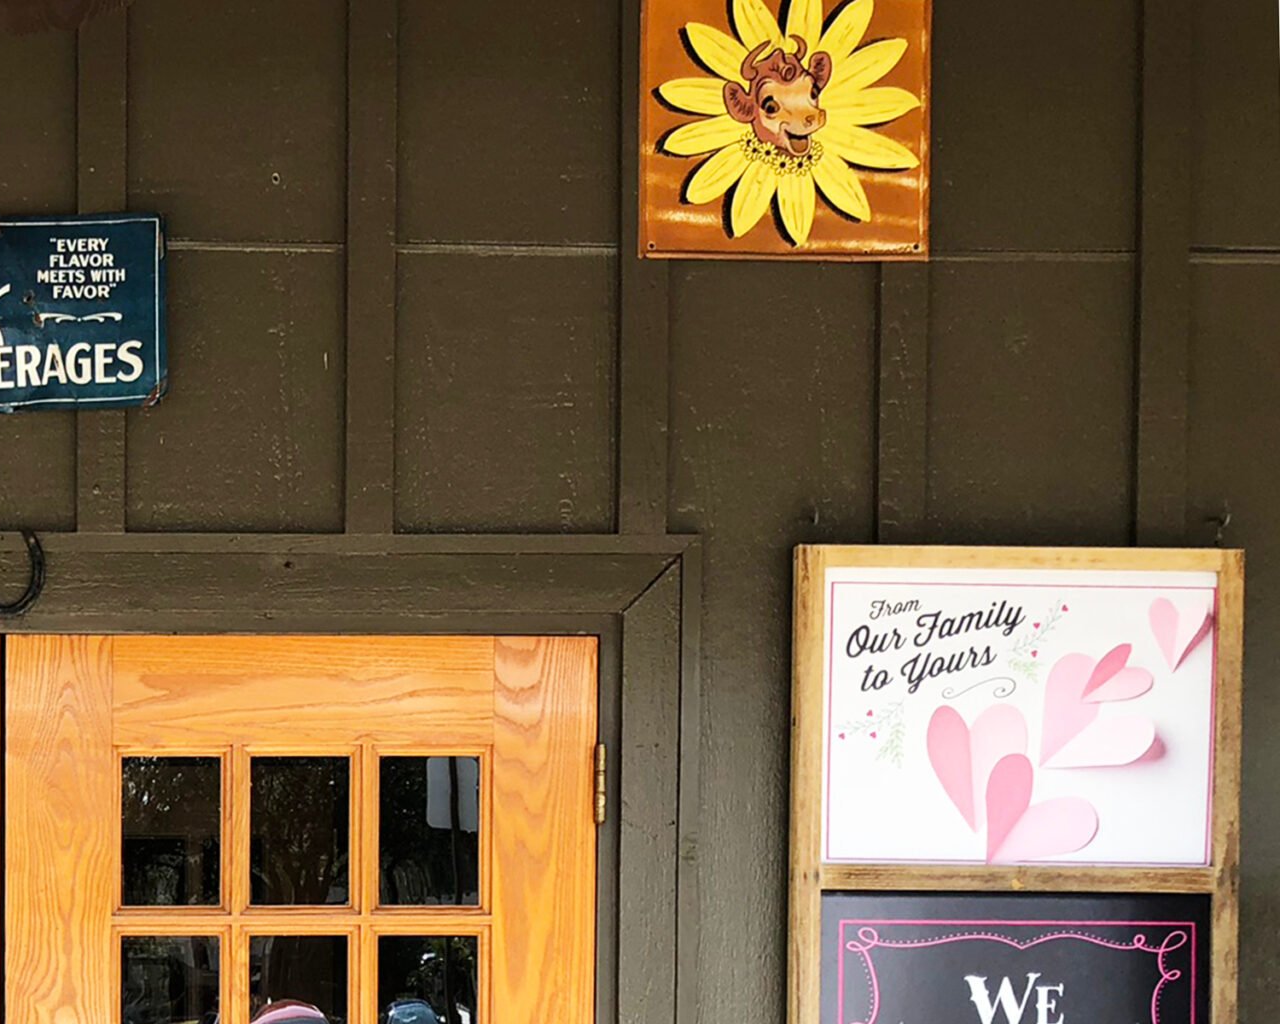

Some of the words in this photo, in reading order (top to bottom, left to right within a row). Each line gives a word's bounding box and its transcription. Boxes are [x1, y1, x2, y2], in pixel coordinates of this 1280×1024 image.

[49, 253, 114, 268] FLAVOR
[36, 269, 87, 284] MEETS
[90, 267, 126, 283] WITH
[869, 598, 923, 621] From
[846, 624, 907, 659] Our
[913, 599, 1027, 648] Family
[860, 664, 894, 693] to
[900, 644, 998, 695] Yours
